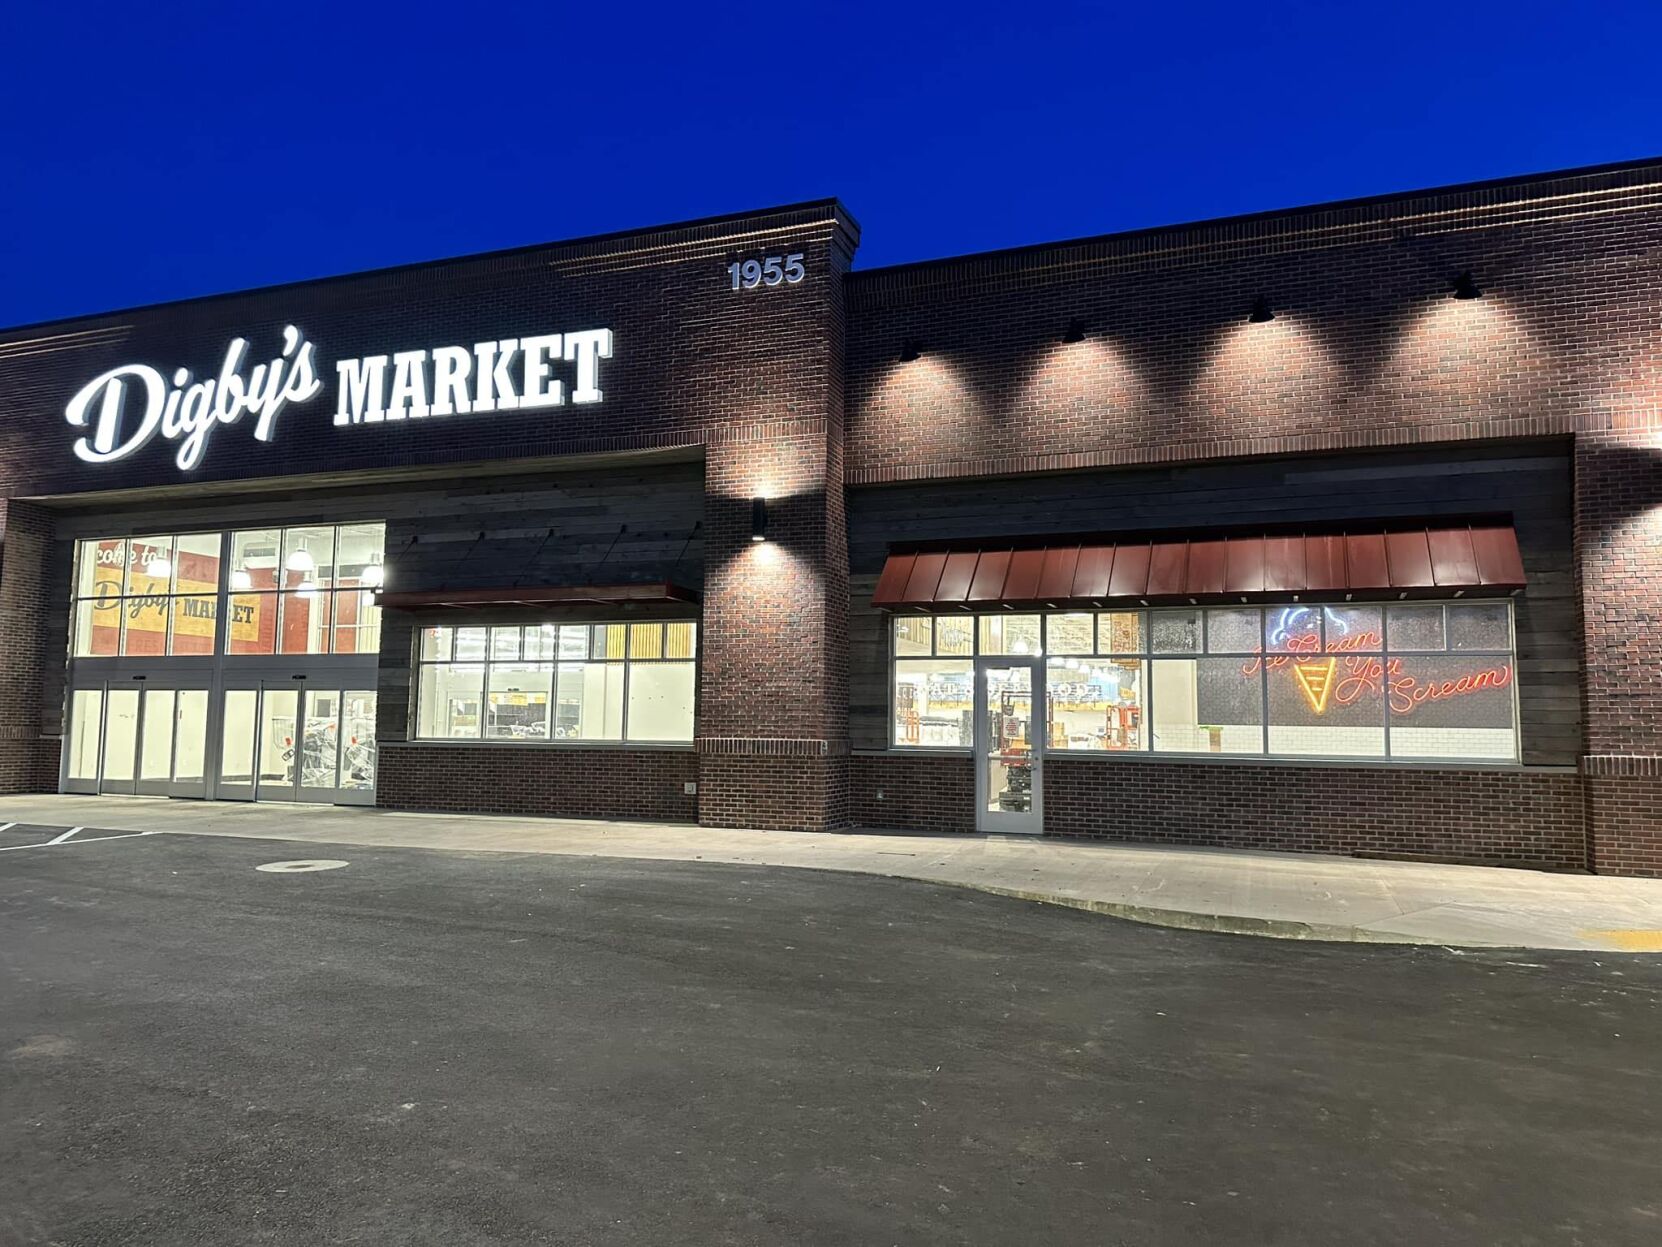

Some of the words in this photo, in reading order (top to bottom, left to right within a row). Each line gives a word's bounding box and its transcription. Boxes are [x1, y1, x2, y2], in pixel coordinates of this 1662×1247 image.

[727, 253, 805, 290] 1955
[65, 324, 324, 471] Digby's
[333, 328, 613, 426] MARKET
[1287, 631, 1384, 662] Cream
[1335, 654, 1401, 703] You
[1383, 664, 1510, 713] Scream
